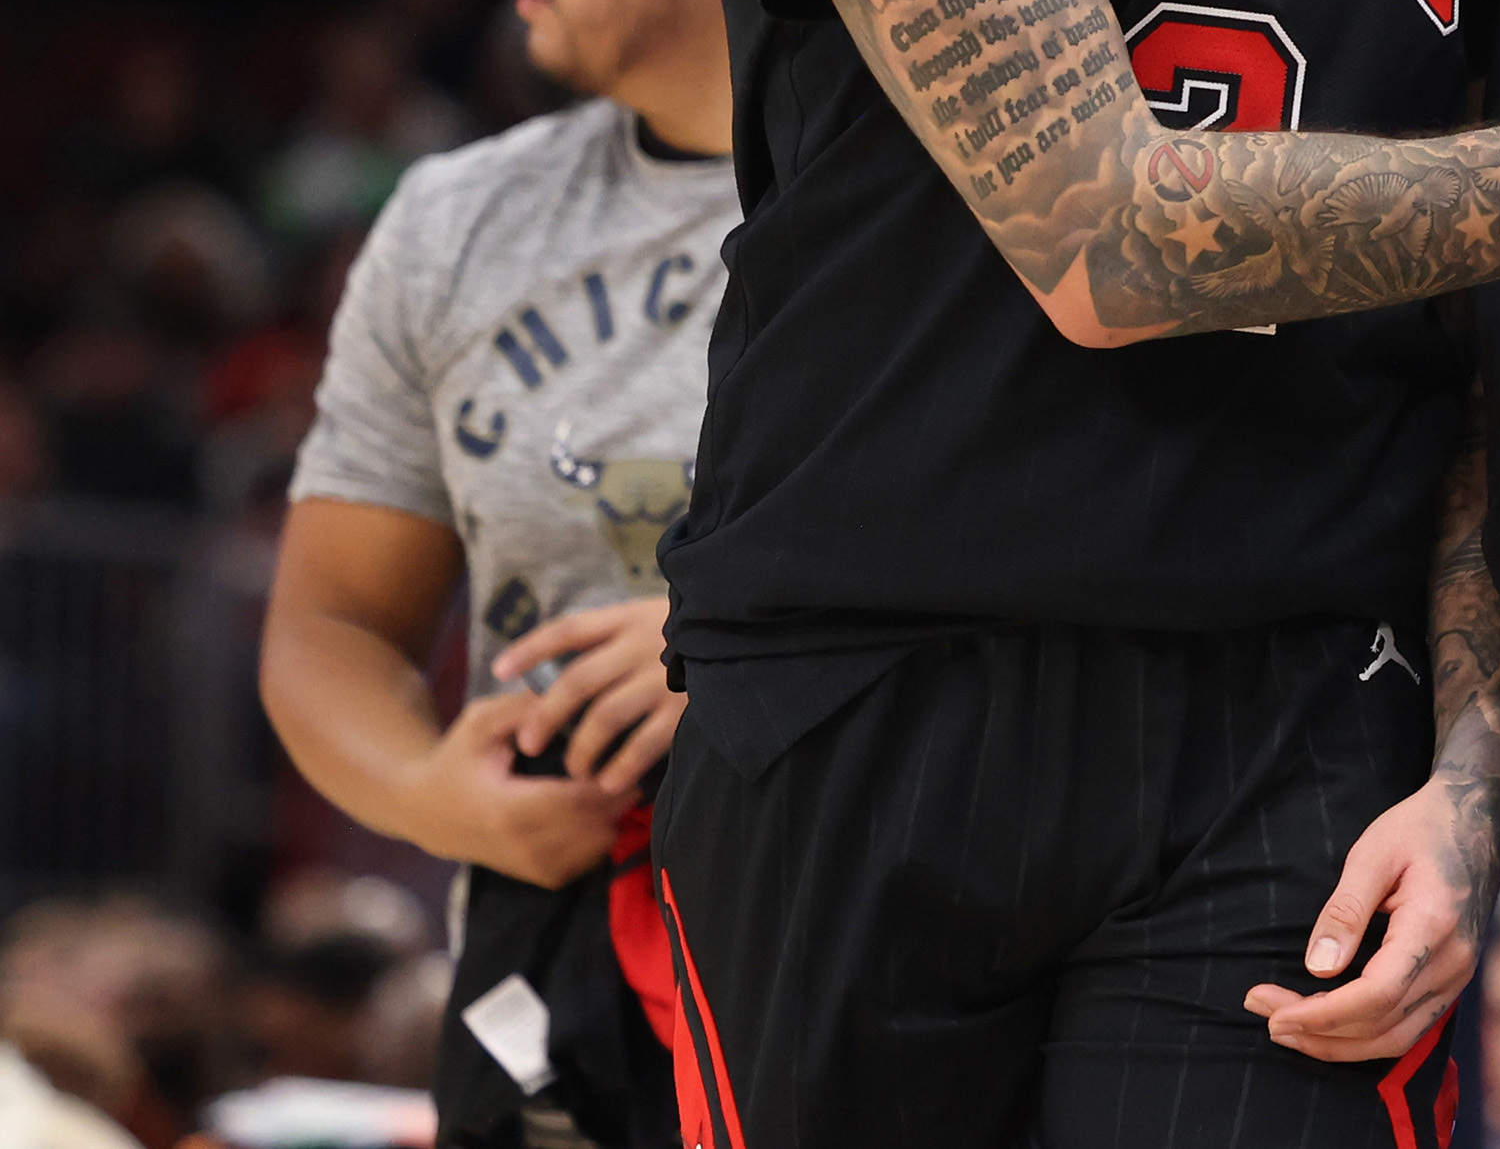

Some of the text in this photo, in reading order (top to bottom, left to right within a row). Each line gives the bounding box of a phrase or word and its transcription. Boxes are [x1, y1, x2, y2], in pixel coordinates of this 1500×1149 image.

[908, 28, 983, 92] through
[979, 13, 1021, 46] the
[932, 95, 962, 127] the
[959, 50, 1041, 106] shadow
[965, 106, 1007, 151] will
[1004, 84, 1049, 125] fear
[996, 142, 1036, 186] you
[1035, 116, 1071, 154] are
[1070, 80, 1117, 125] with
